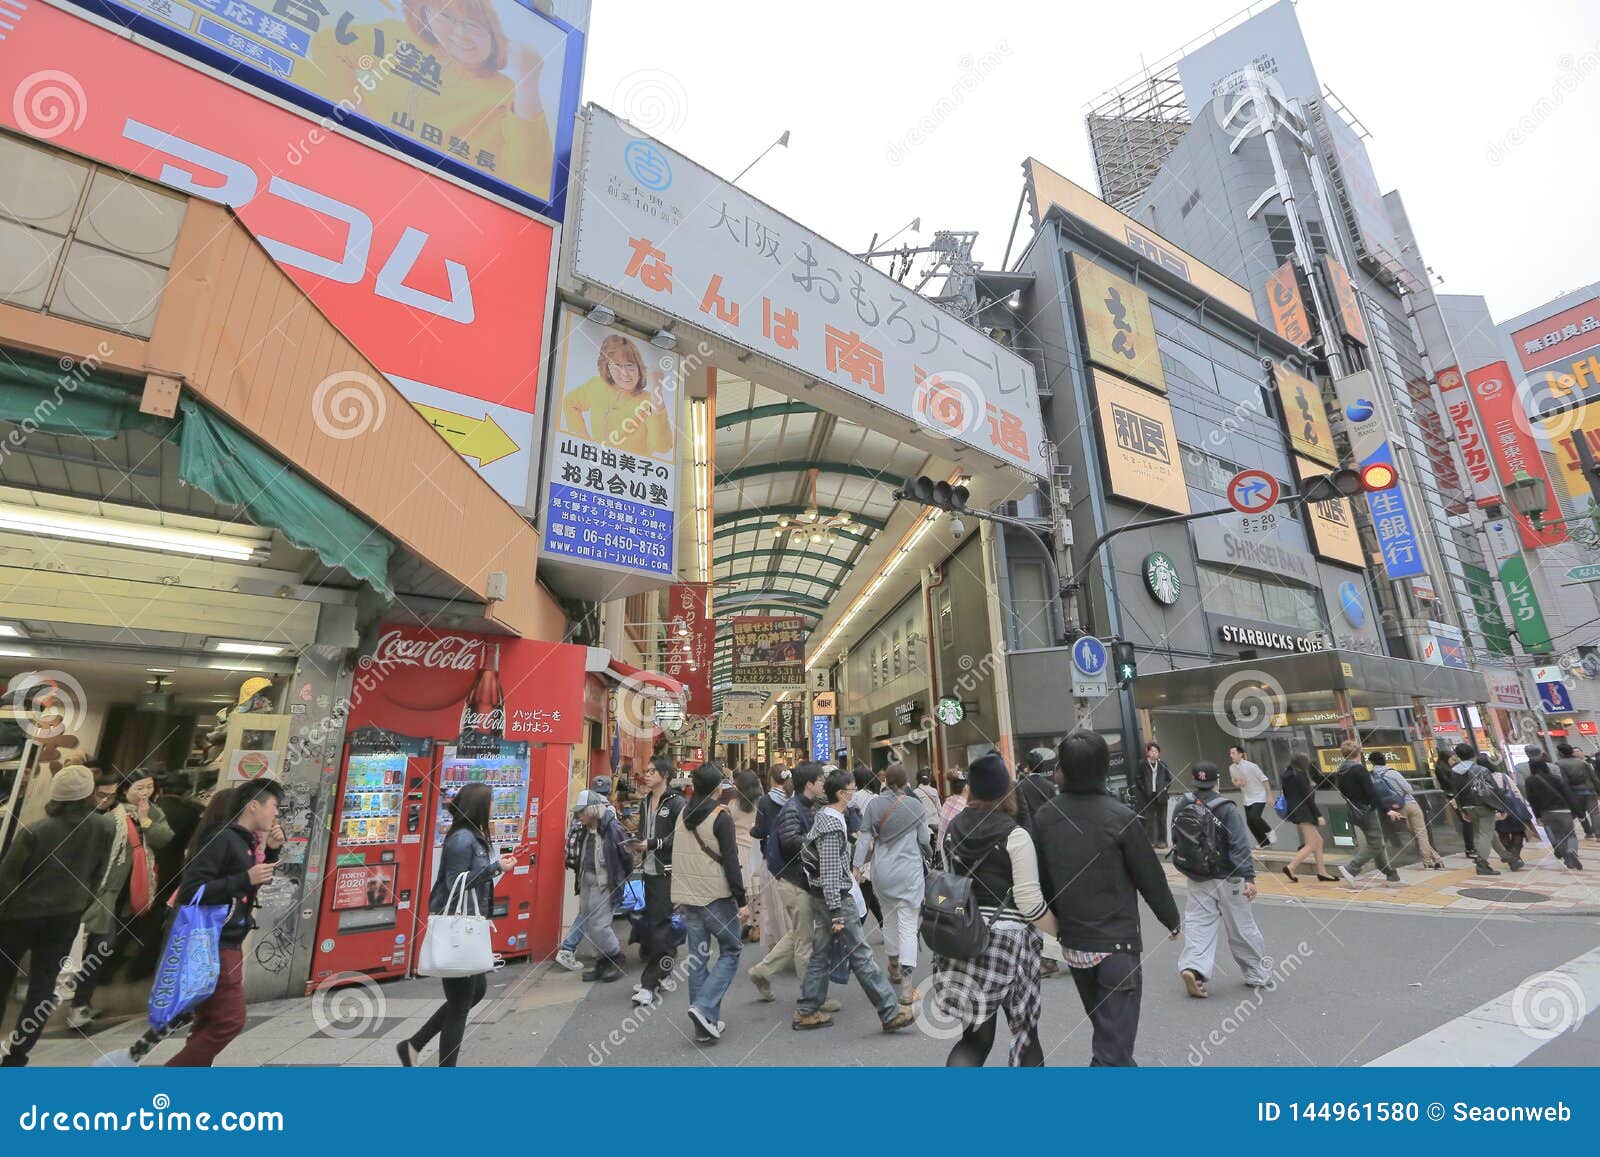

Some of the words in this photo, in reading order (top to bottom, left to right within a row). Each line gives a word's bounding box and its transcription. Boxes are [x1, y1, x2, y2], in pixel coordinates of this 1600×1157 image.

[391, 111, 497, 172] 山田塾長
[624, 236, 1031, 463] なんば南海通
[1108, 403, 1171, 466] 和民
[1449, 401, 1491, 484] ジャンカラ
[560, 440, 669, 480] 山田由美子の
[561, 461, 668, 507] お見合い塾
[551, 522, 577, 539] 電話
[583, 528, 666, 558] 06-6450-8753
[1509, 581, 1536, 622] レイク
[371, 630, 484, 671] Coca-Cola
[1222, 625, 1294, 651] STARBUCKS
[511, 721, 554, 733] あけよう。
[513, 709, 561, 721] ハッピーを
[339, 879, 365, 889] 2020
[340, 871, 366, 881] TOKYO
